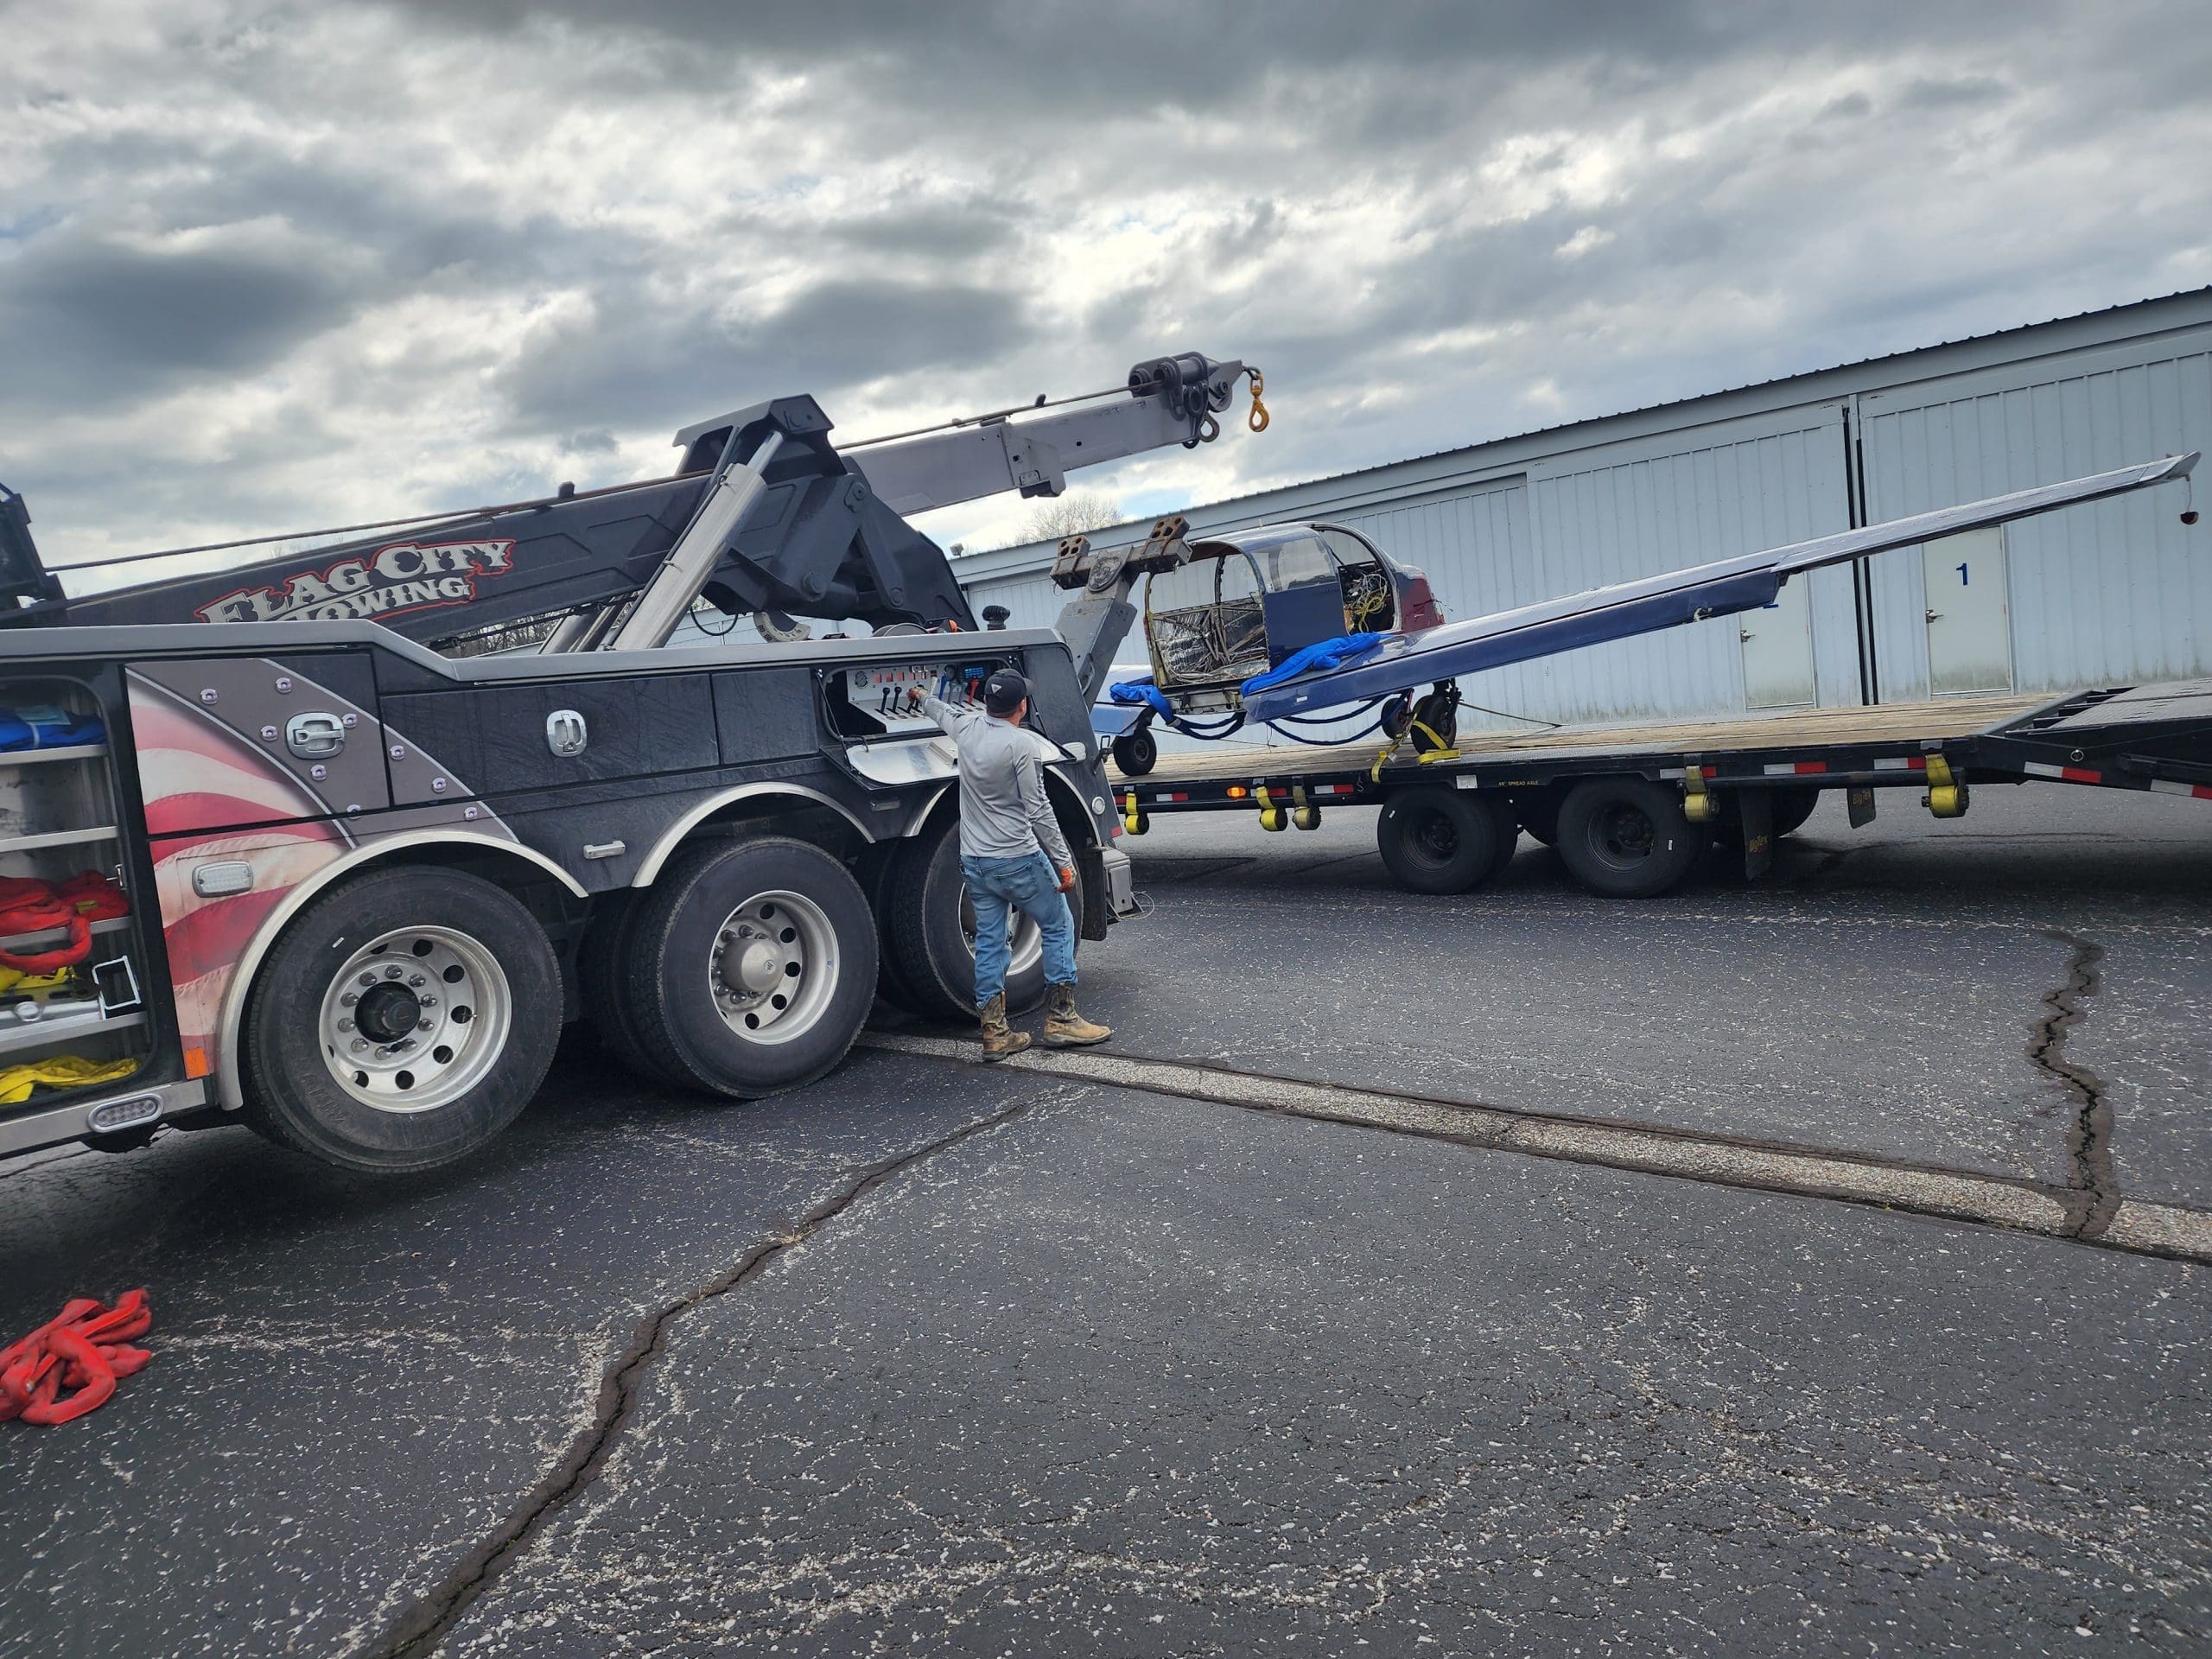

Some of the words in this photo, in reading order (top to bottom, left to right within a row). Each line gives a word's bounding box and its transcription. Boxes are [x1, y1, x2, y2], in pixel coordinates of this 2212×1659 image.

[200, 562, 371, 623] FLAG
[374, 542, 510, 580] CITY
[1955, 563, 1968, 586] 1
